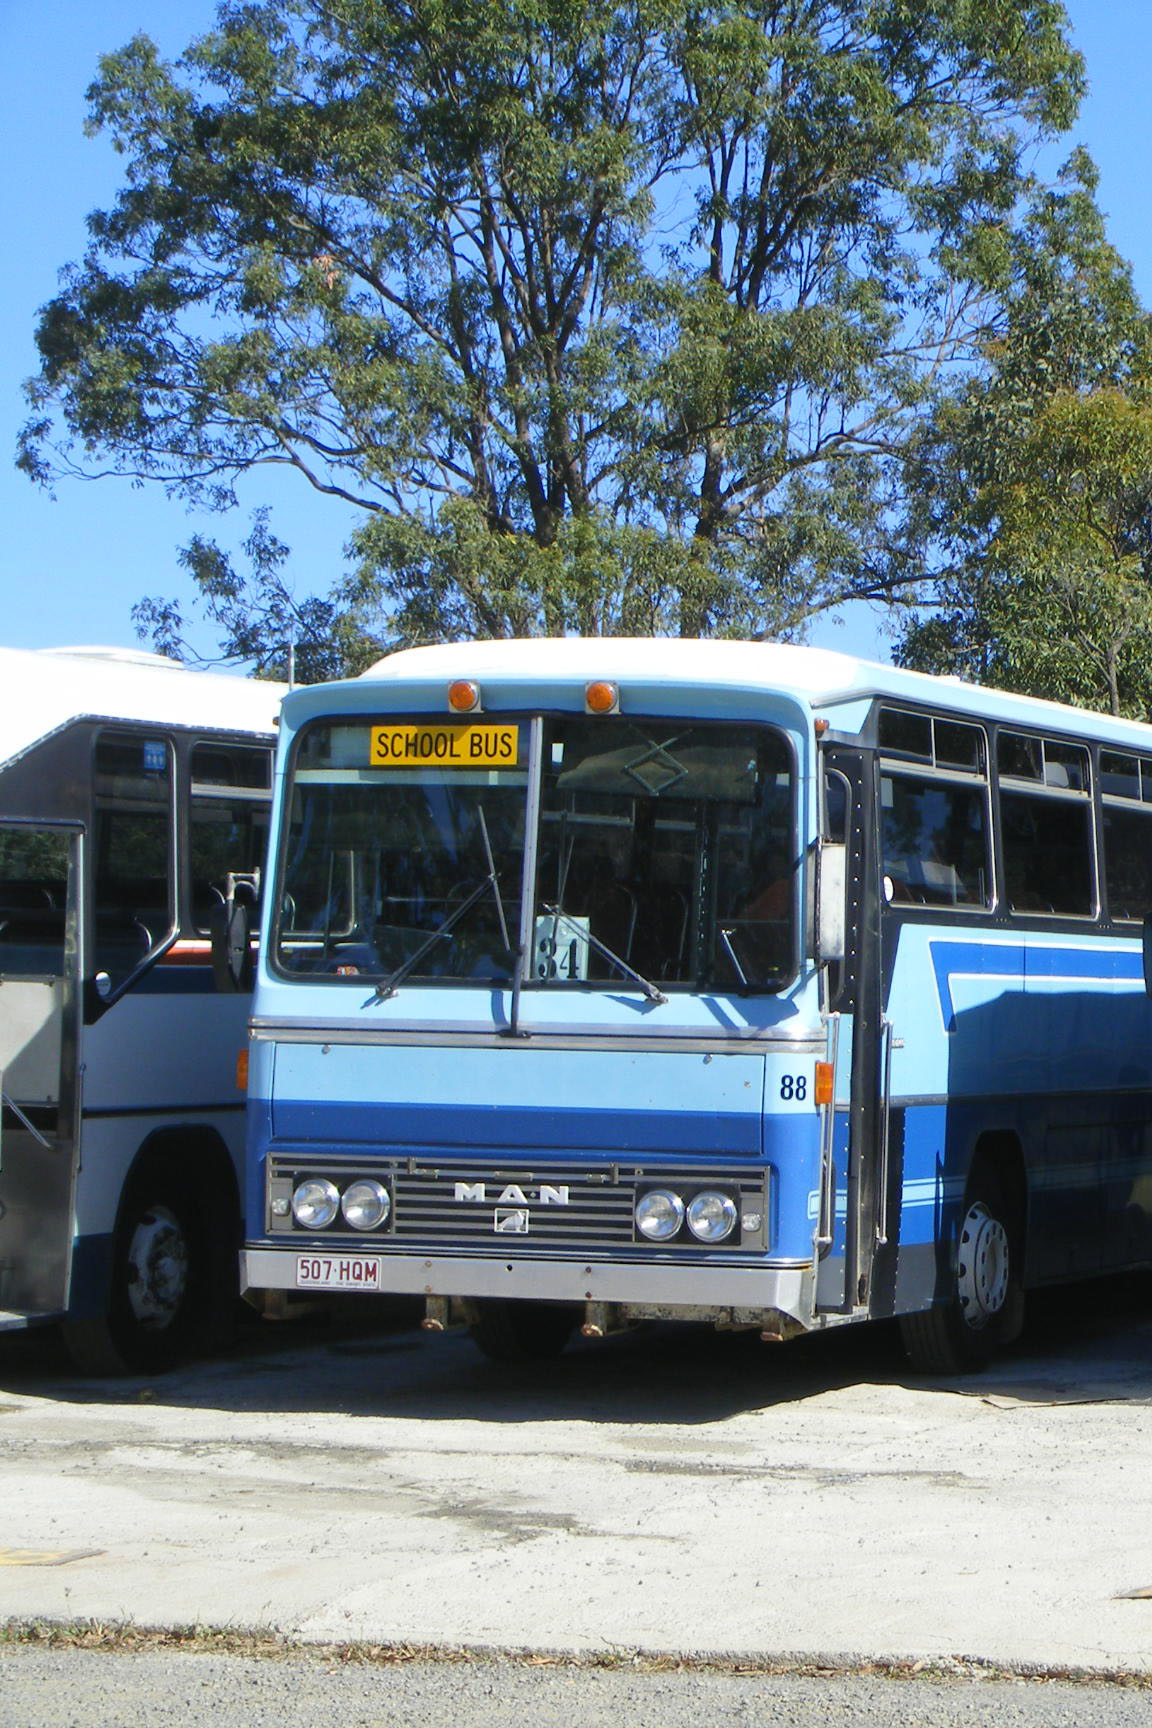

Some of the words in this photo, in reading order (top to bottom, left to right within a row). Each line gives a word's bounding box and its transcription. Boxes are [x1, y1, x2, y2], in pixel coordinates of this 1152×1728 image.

[376, 732, 461, 758] SCHOOL
[470, 732, 513, 758] BUS
[538, 937, 580, 979] 34
[780, 1074, 807, 1100] 88
